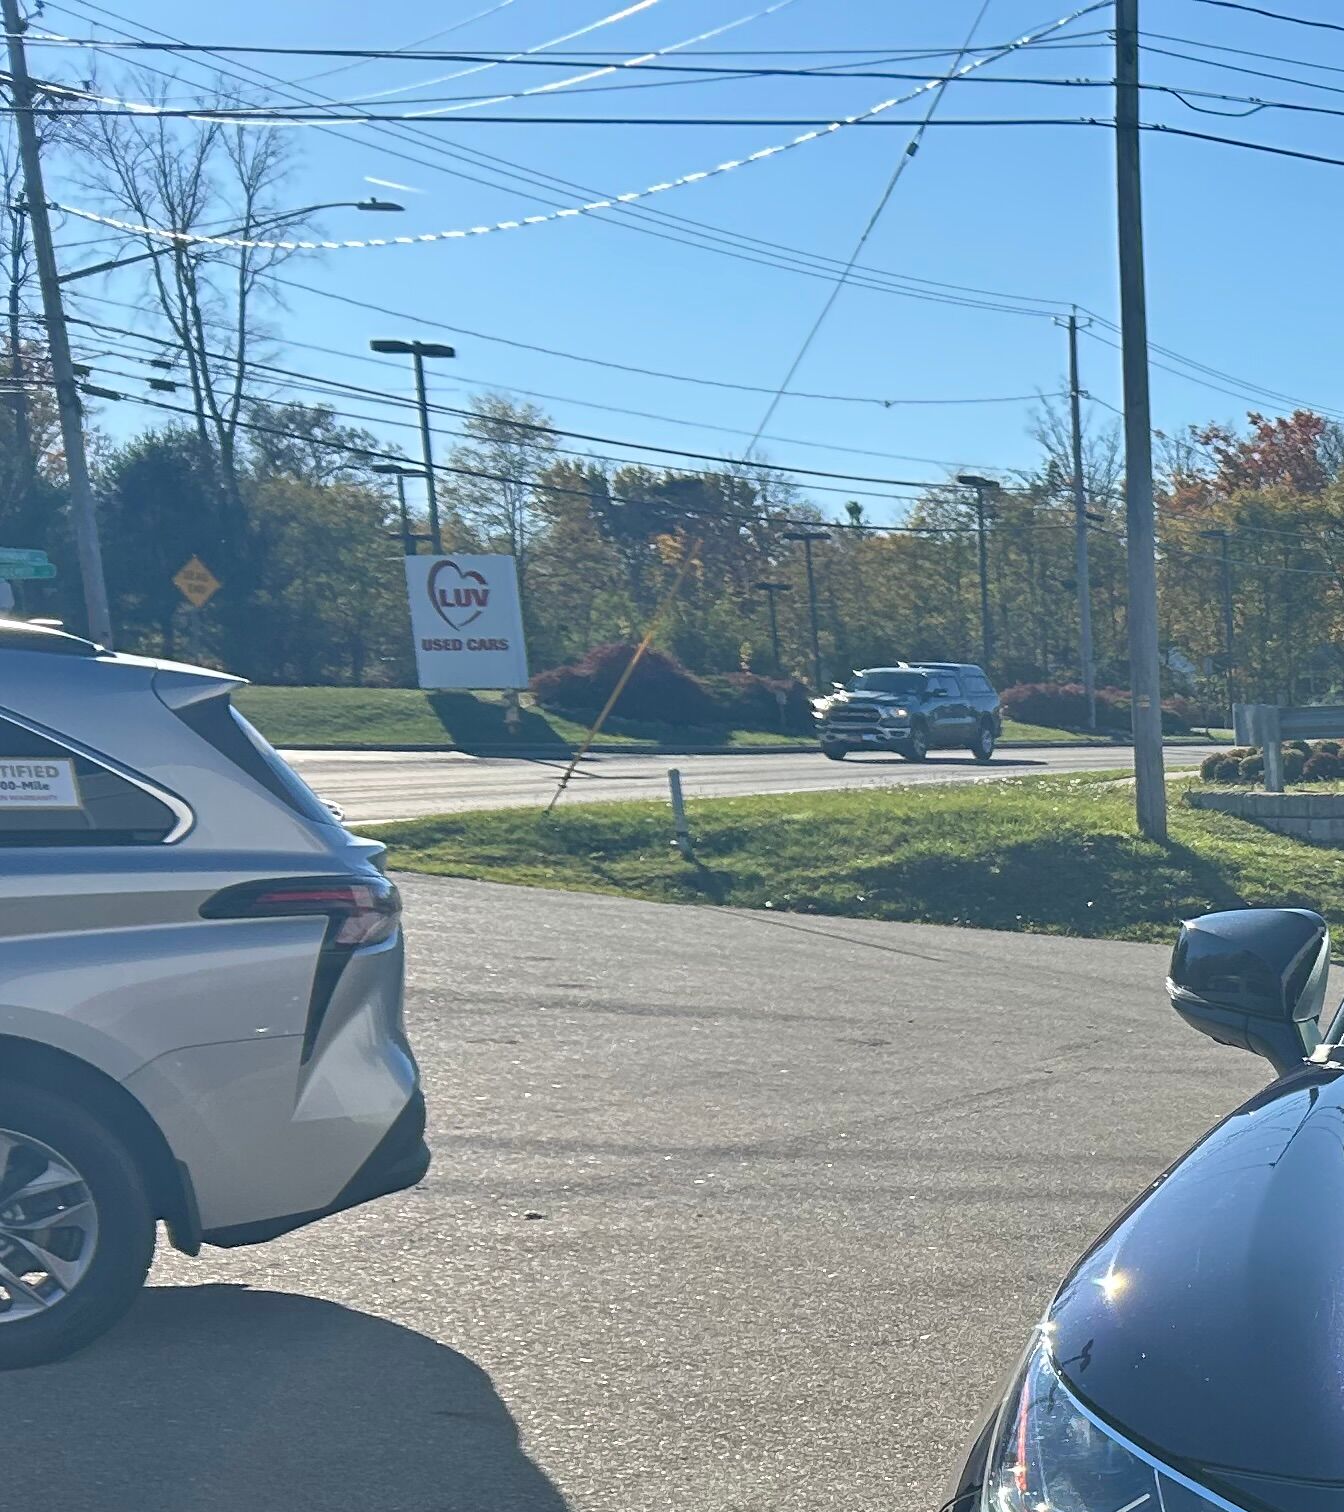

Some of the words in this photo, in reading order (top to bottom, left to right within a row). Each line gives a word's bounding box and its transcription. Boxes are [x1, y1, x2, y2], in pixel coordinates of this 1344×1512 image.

[439, 588, 490, 608] LUV
[421, 638, 463, 652] USED
[465, 638, 510, 652] CARS
[0, 781, 50, 791] 00-Mile
